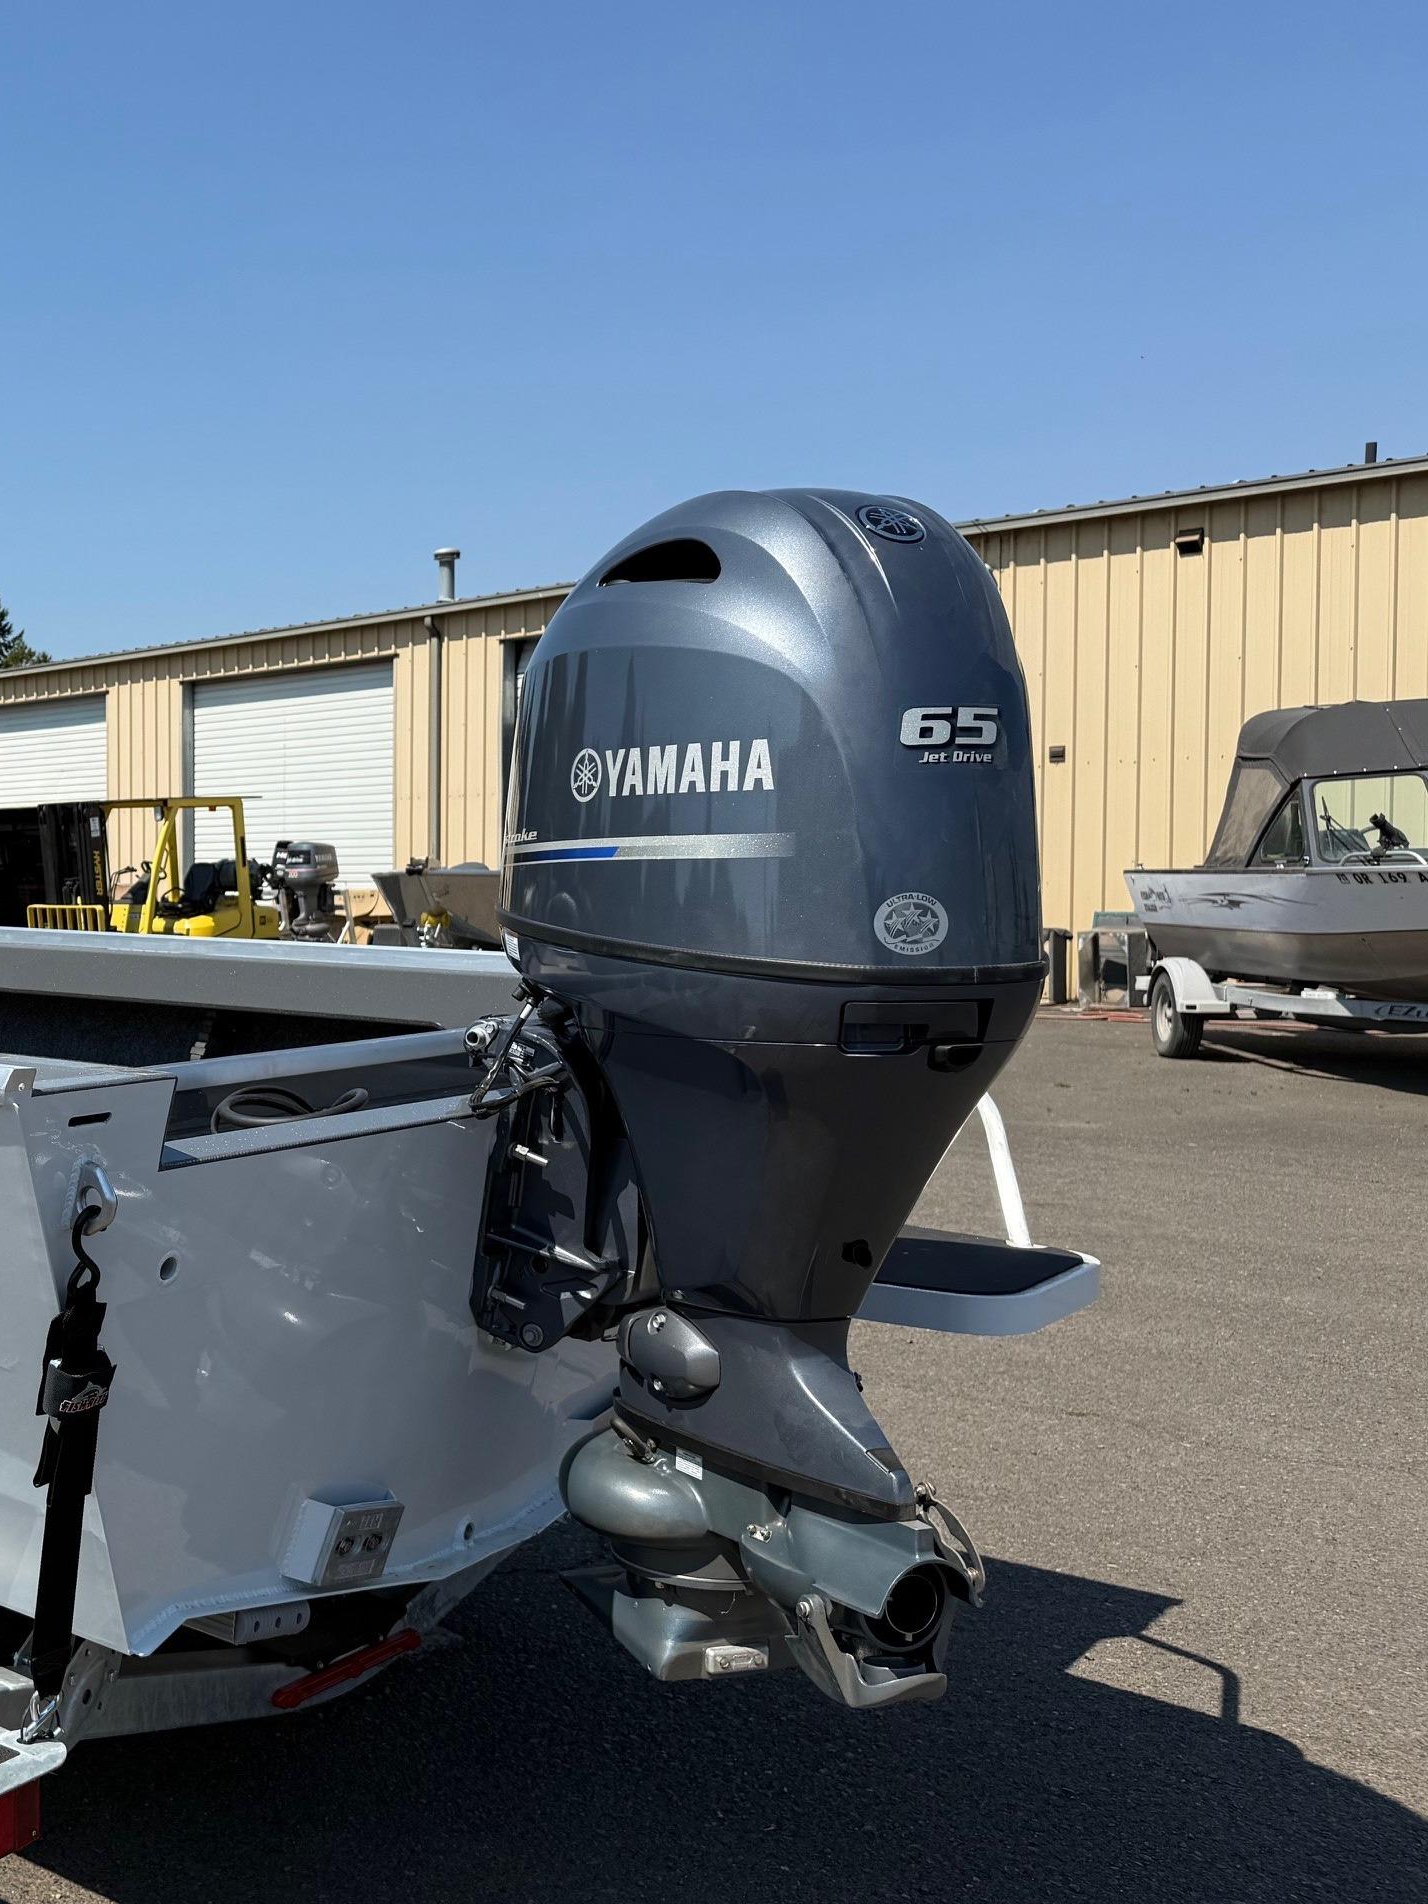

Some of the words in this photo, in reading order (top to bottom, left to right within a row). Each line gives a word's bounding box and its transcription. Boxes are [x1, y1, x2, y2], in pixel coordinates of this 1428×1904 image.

[900, 706, 999, 746] 65
[605, 738, 775, 797] YAMAHA
[918, 750, 948, 763] Jet
[952, 750, 992, 763] Drive
[93, 850, 104, 896] HYSTER
[1352, 872, 1373, 885] OR
[1377, 871, 1408, 884] 169
[893, 942, 935, 953] EMISSION
